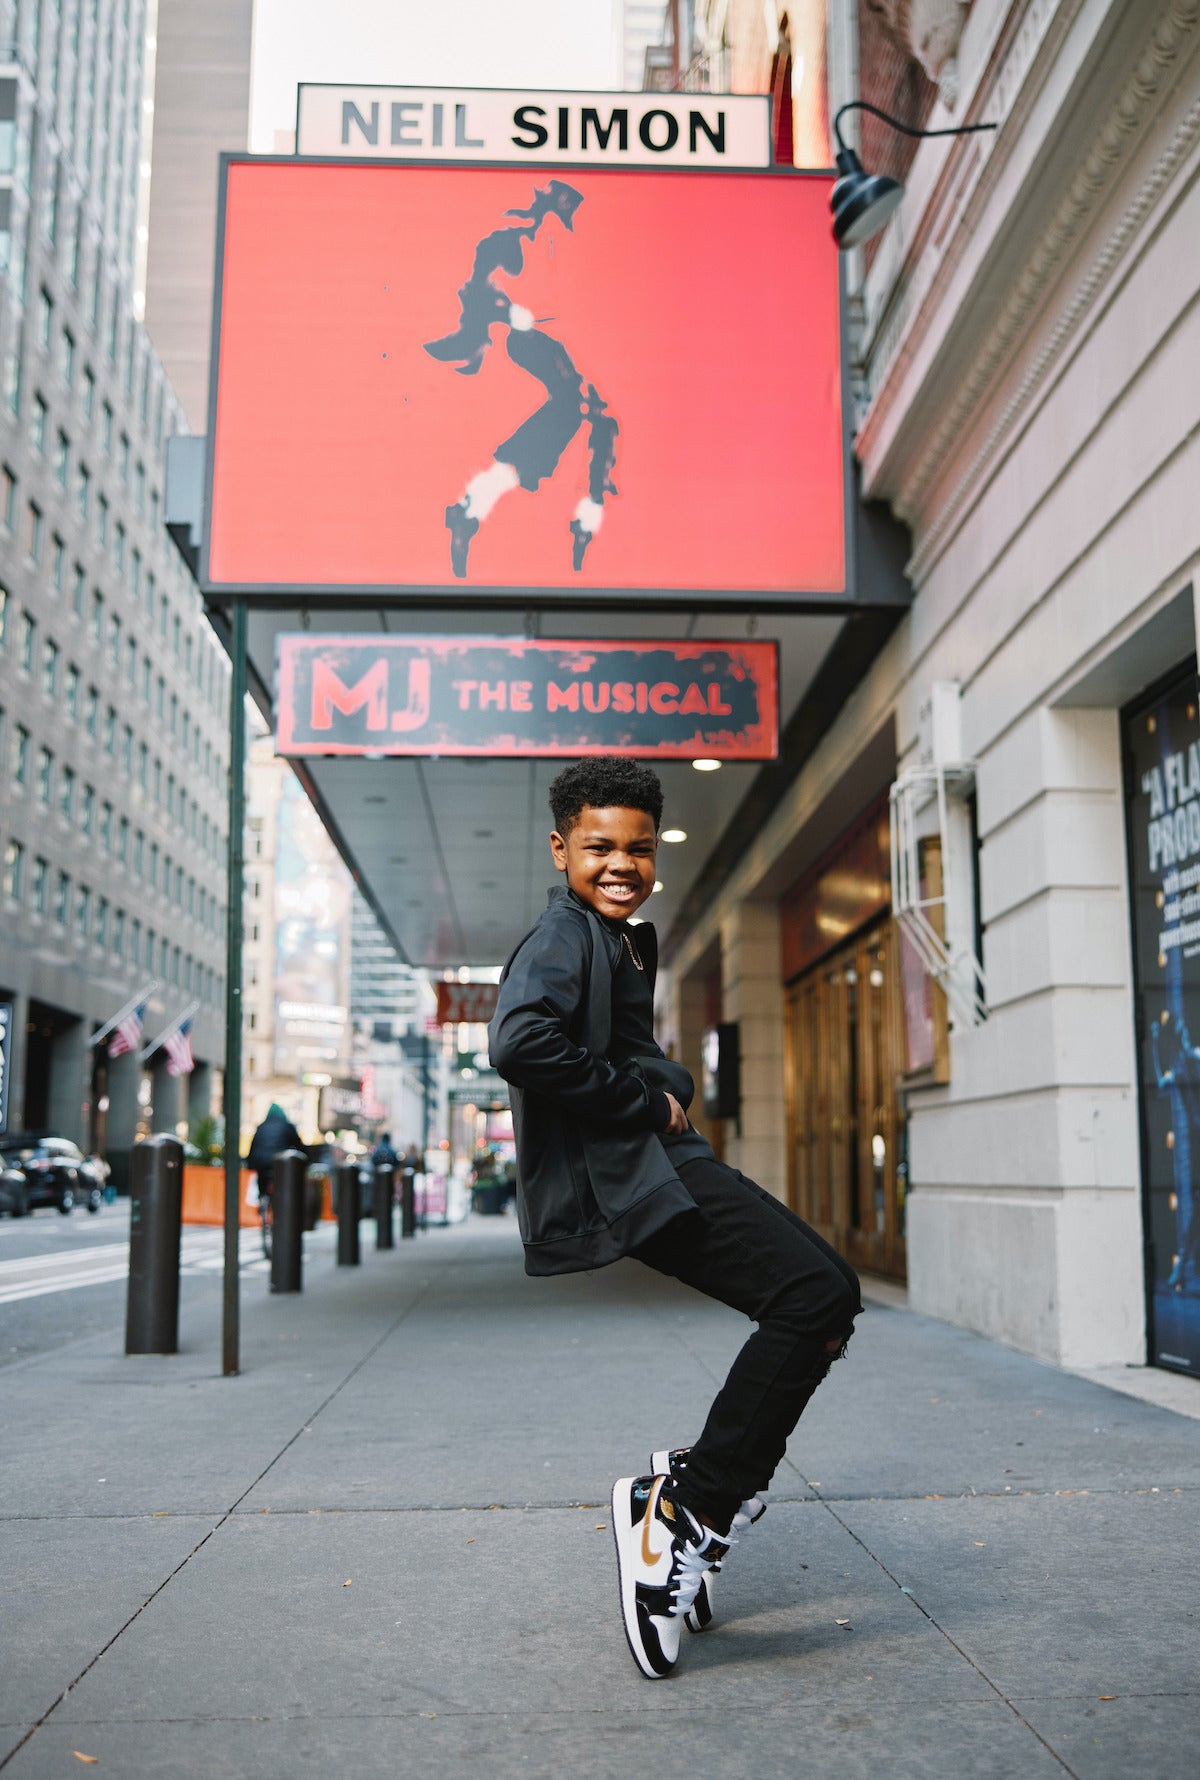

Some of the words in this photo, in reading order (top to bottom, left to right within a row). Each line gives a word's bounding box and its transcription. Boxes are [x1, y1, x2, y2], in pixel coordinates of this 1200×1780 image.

[341, 101, 484, 147] NEIL
[511, 105, 726, 154] SIMON
[311, 657, 431, 732] MJ
[451, 680, 533, 711] THE
[547, 681, 733, 716] MUSICAL
[1164, 738, 1200, 810] FLA
